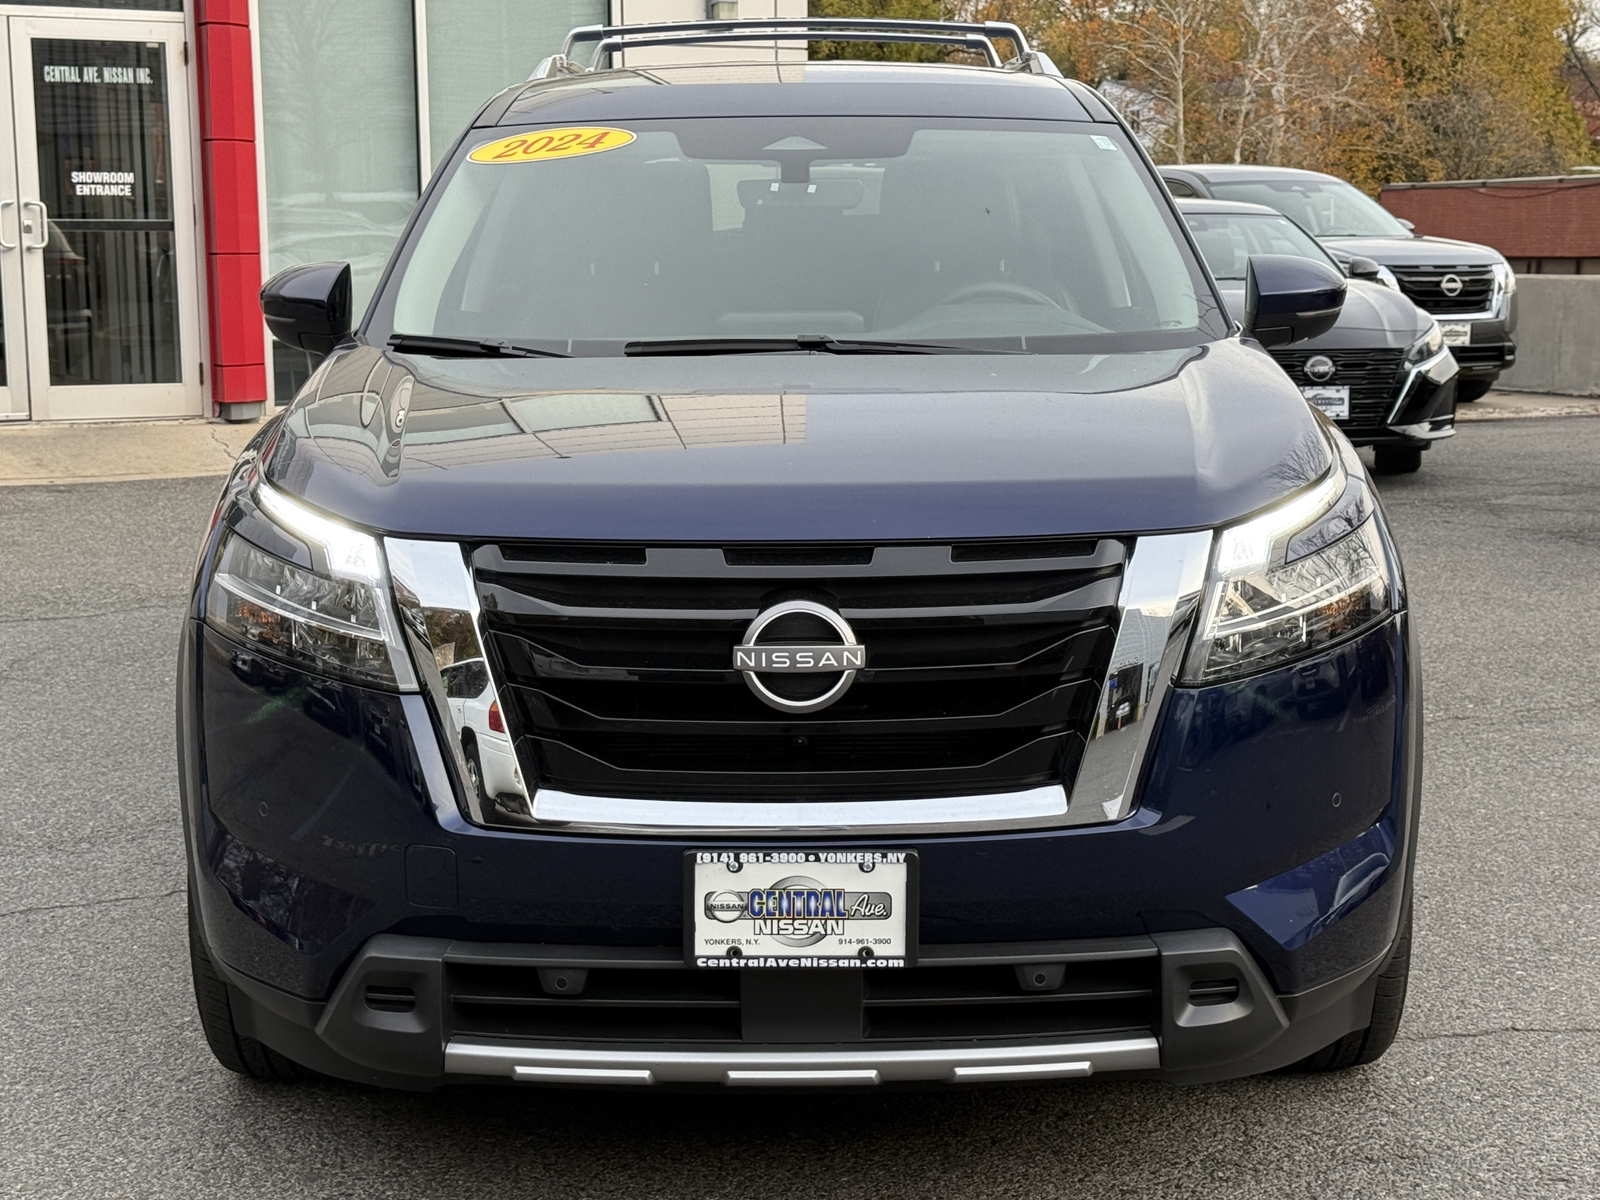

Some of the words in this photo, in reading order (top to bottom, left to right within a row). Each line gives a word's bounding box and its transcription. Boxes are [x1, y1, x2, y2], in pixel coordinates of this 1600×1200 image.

[44, 66, 81, 82] CENTRAL
[83, 67, 101, 83] AVE.
[103, 67, 134, 83] NISSAN
[136, 68, 153, 84] INC.
[492, 131, 611, 160] 2024
[71, 172, 134, 183] SHOWROOM
[76, 184, 132, 196] ENTRANCE
[737, 651, 861, 667] NISSAN
[740, 853, 806, 863] 961-3900
[749, 889, 849, 919] CENTRAL
[850, 893, 888, 917] Ave.
[754, 919, 844, 935] NISSAN
[697, 957, 904, 967] CentralAveNissan.com
